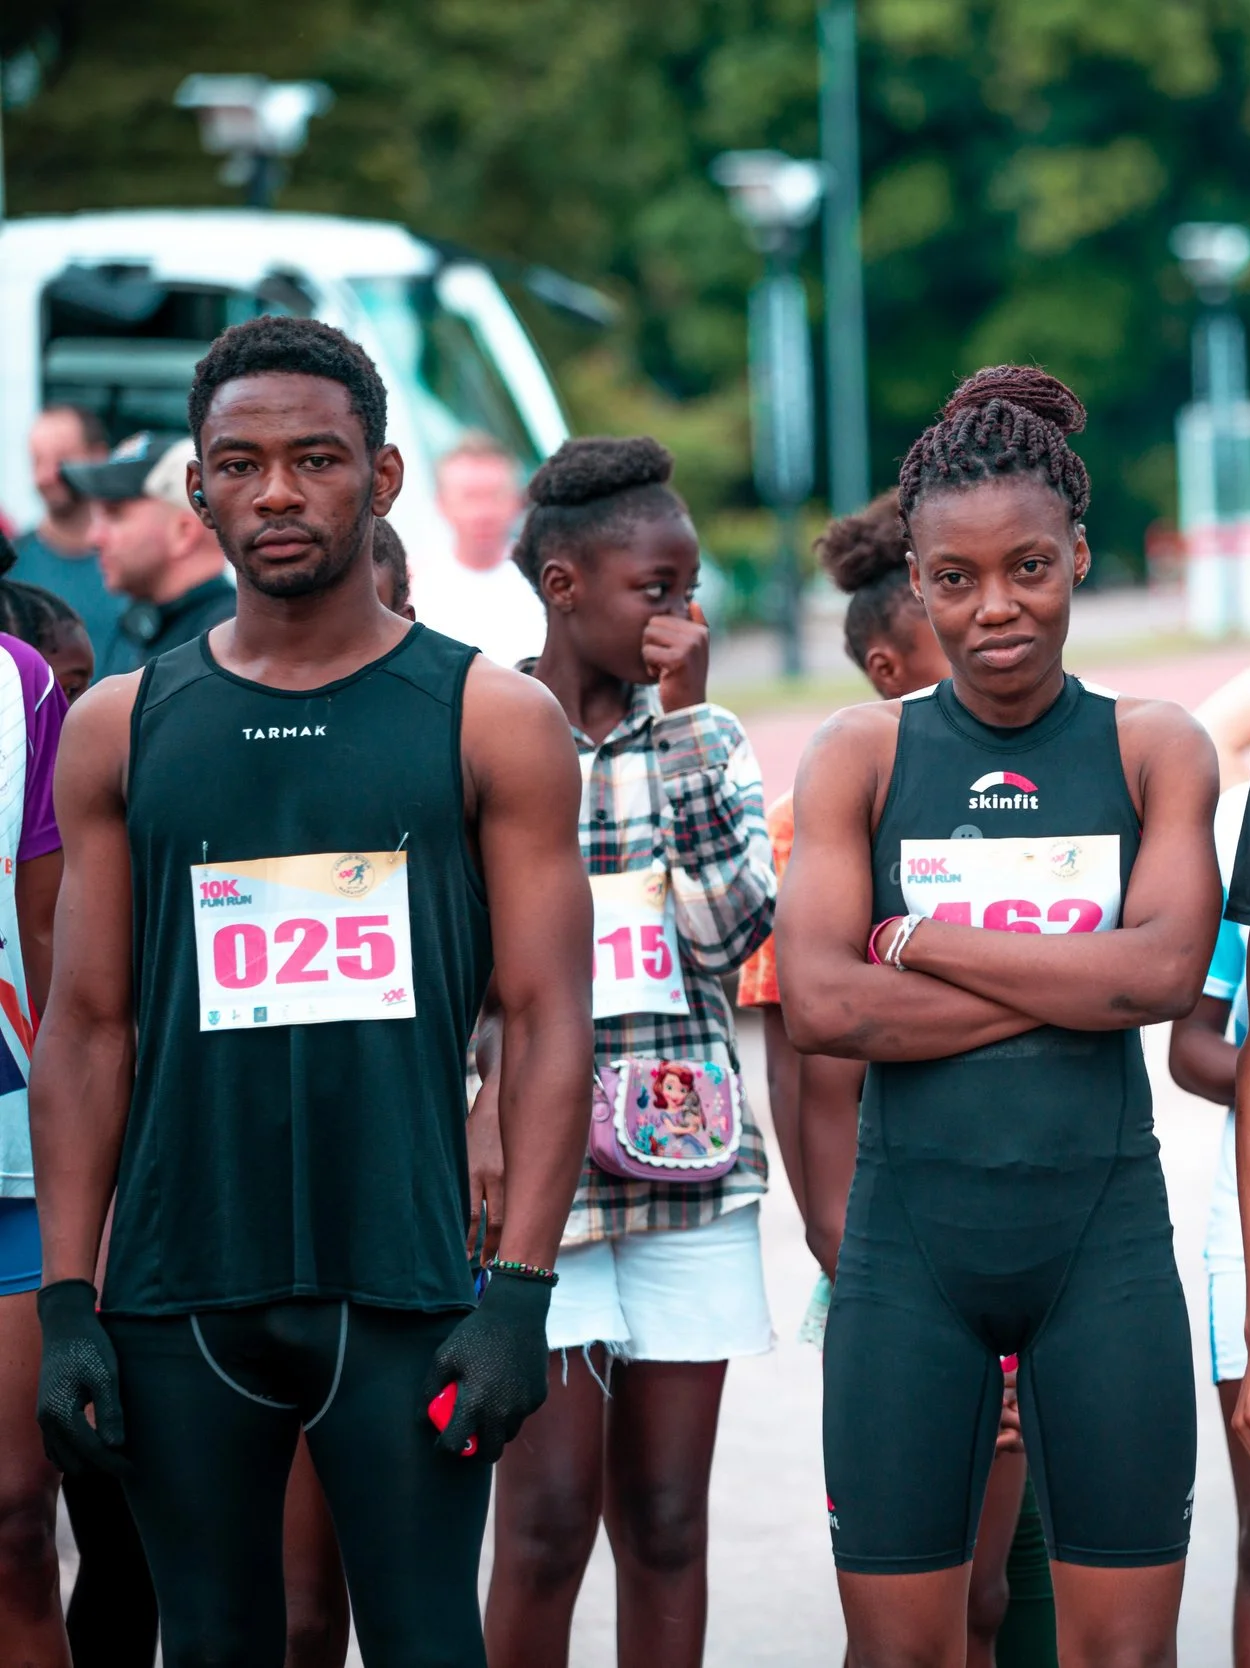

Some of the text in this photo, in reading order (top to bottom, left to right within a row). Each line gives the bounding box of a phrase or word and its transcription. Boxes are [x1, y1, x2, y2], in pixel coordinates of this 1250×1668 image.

[242, 725, 327, 740] TARMAK
[968, 794, 1039, 809] skinfit
[907, 858, 949, 875] 10K
[907, 873, 961, 884] FUN RUN
[200, 879, 240, 899] 10K
[200, 894, 252, 908] FUN RUN
[213, 915, 396, 990] 025
[593, 925, 673, 980] 15
